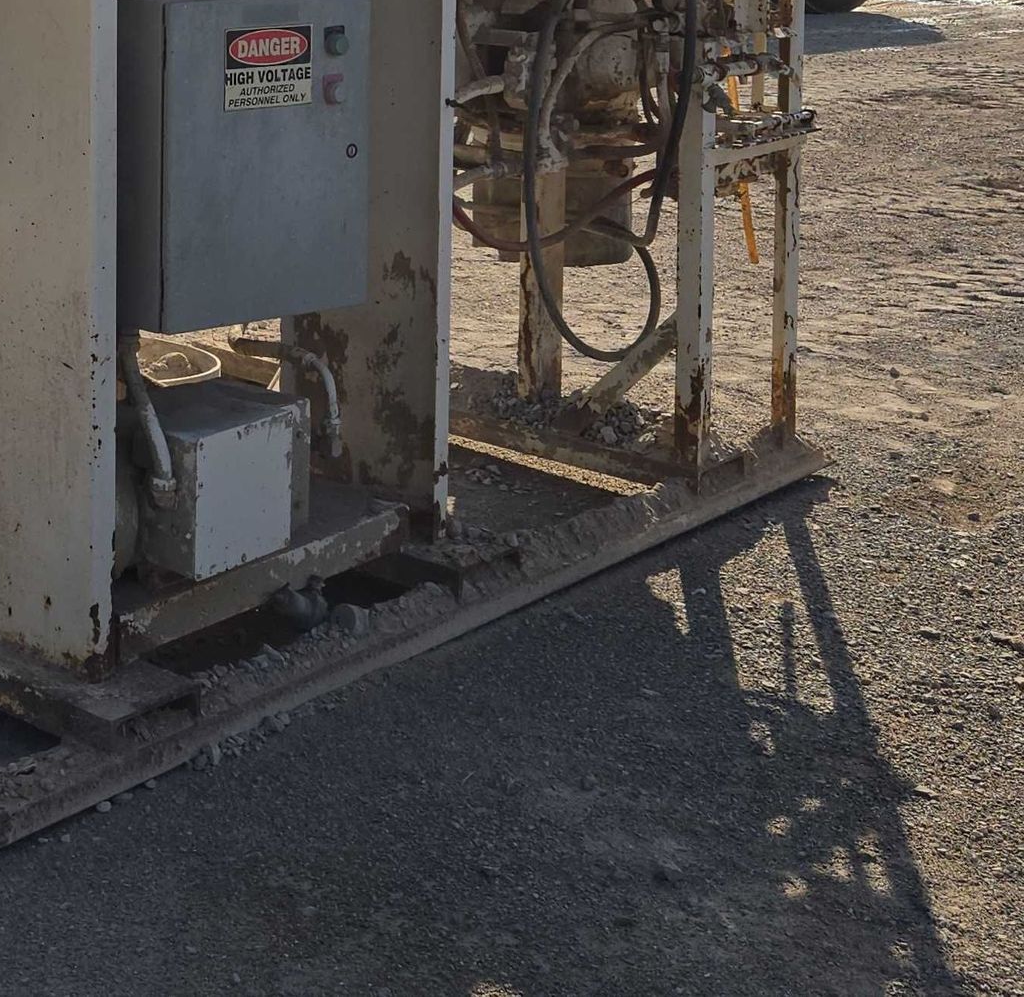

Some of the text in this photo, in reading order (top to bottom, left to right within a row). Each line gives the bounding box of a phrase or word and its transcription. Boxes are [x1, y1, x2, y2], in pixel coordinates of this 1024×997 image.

[237, 37, 301, 58] DANGER
[225, 67, 311, 86] HIGH VOLTAGE
[240, 84, 295, 96] AUTHORIZED
[228, 93, 306, 107] PERSONNEL ONLY
